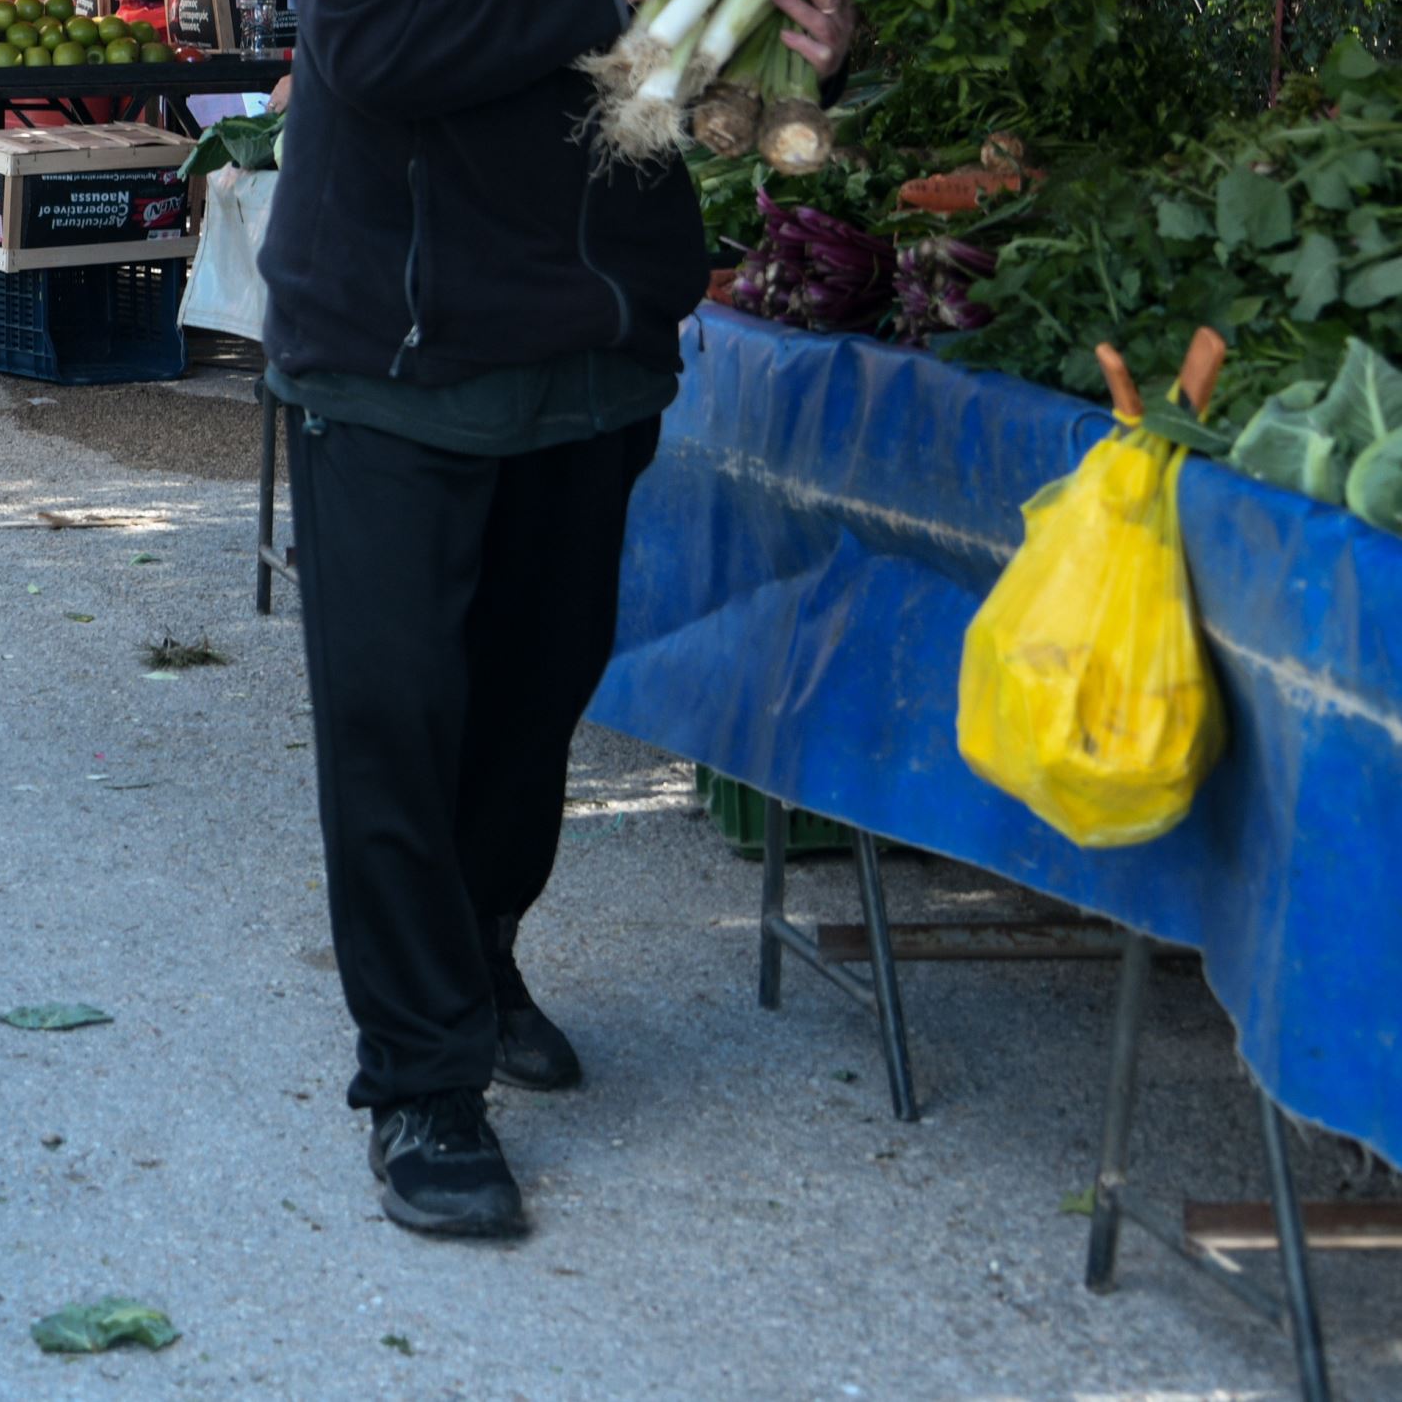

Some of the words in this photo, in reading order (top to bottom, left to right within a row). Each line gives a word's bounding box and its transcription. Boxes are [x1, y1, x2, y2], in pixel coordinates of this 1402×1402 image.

[70, 190, 130, 204] Naoussa
[37, 204, 54, 218] of
[54, 203, 129, 217] Cooperative
[51, 215, 127, 229] Agricultural
